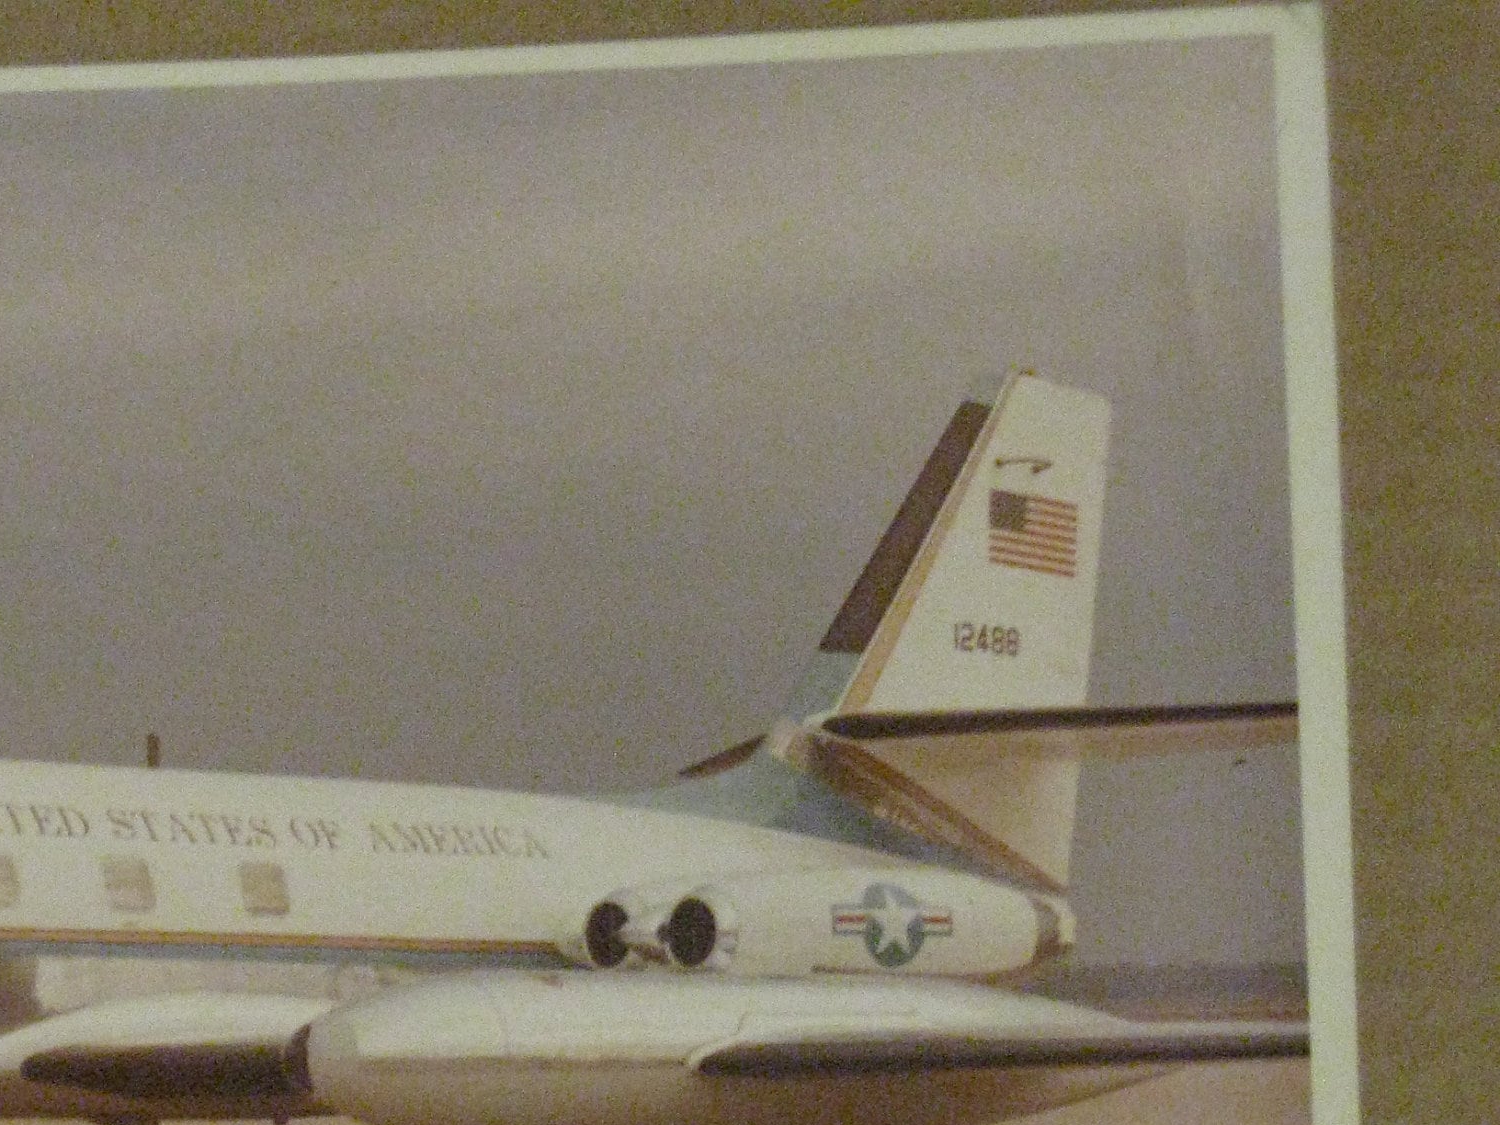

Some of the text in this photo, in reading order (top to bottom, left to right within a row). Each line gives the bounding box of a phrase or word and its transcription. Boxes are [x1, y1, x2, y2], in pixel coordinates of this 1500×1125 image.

[106, 808, 278, 849] STATES
[288, 817, 339, 851] OF
[367, 821, 553, 860] AMERICA
